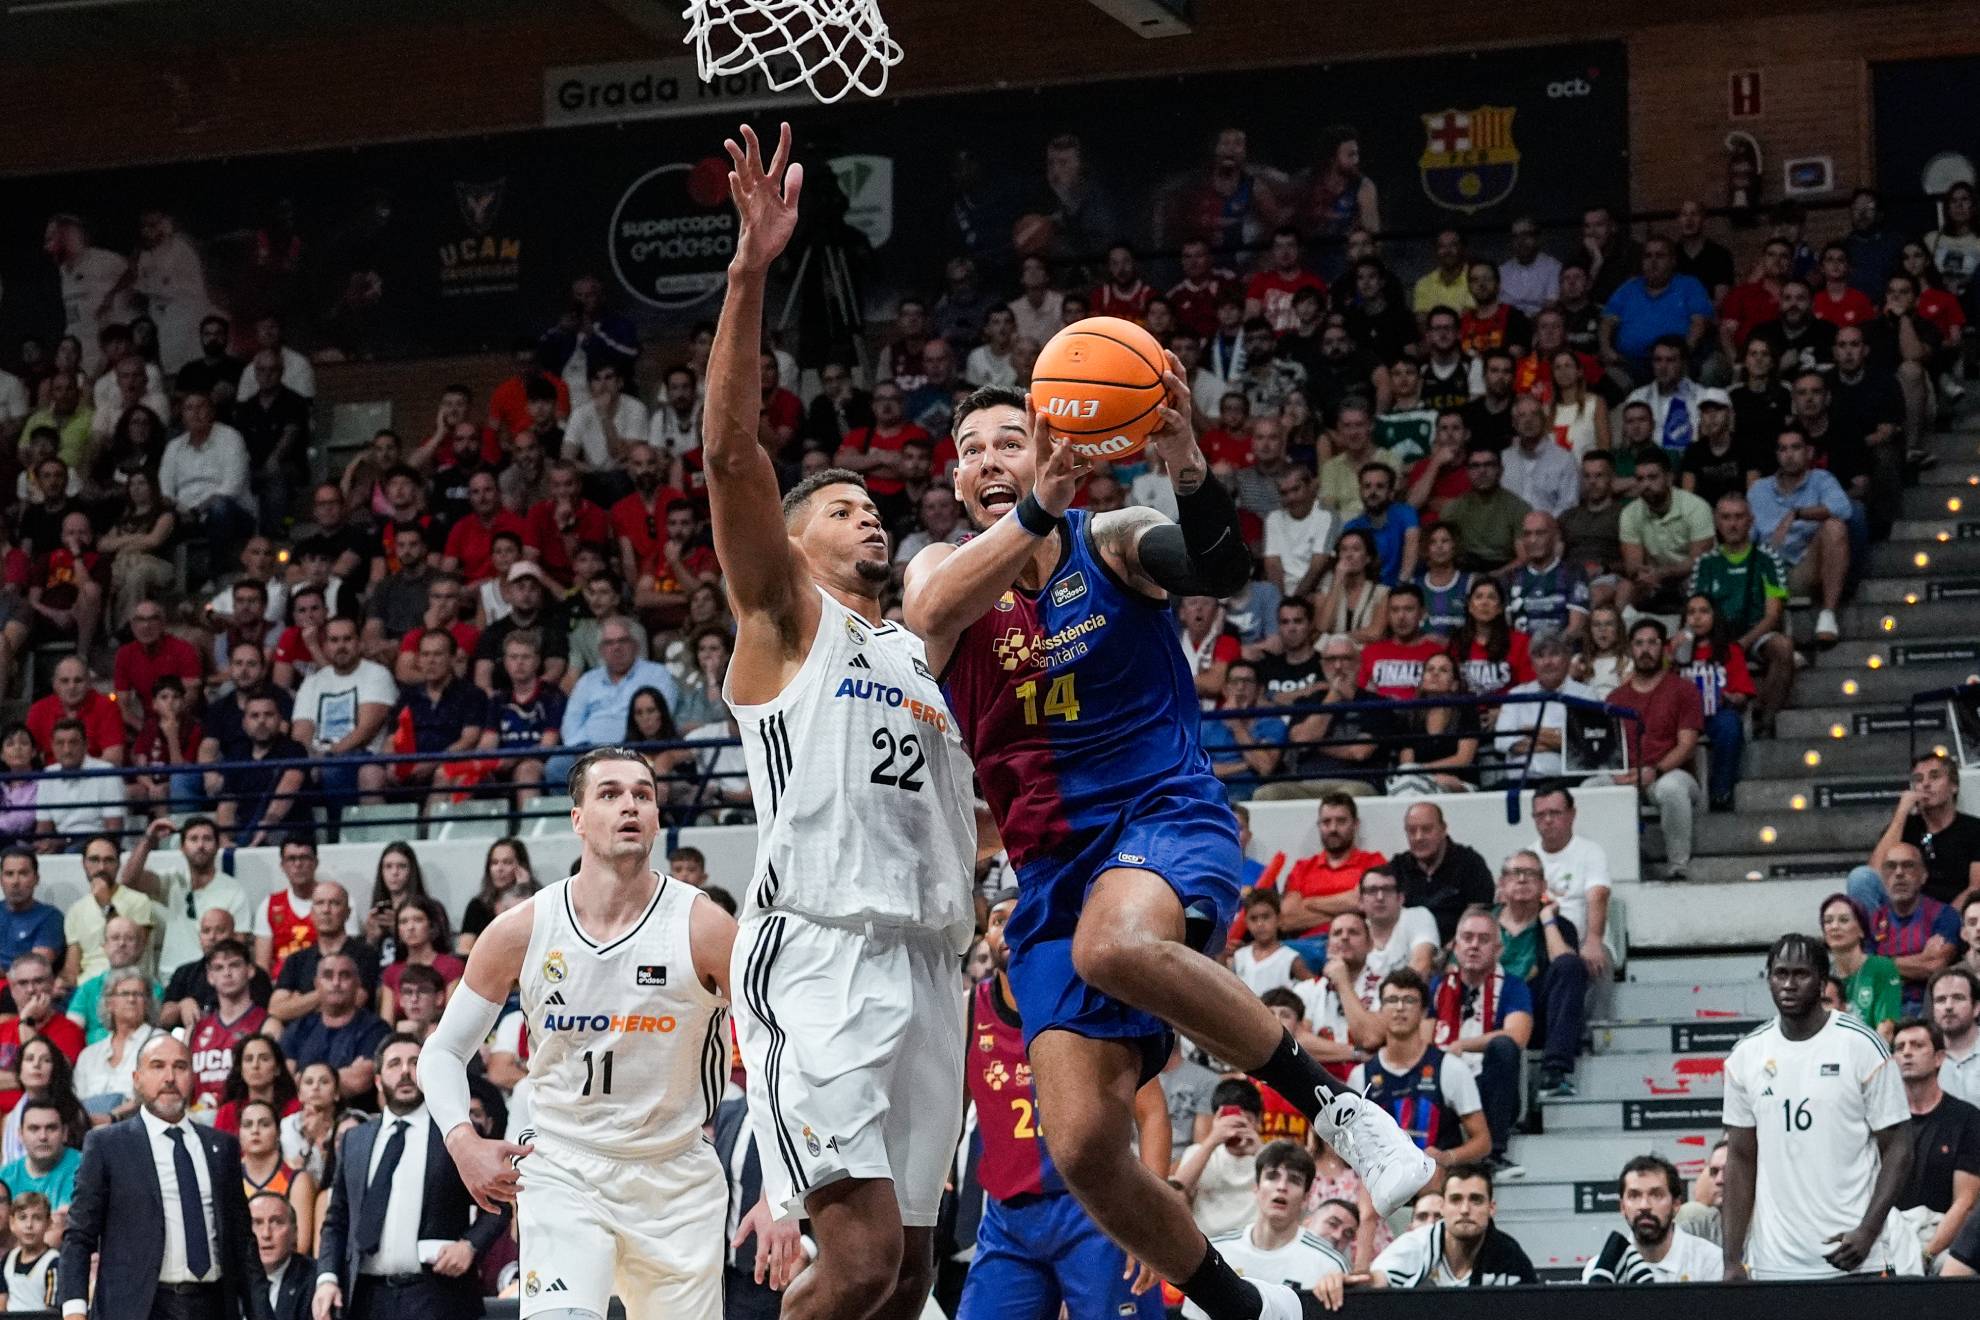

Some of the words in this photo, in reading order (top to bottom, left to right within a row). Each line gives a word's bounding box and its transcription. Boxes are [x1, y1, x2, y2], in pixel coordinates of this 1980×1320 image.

[558, 75, 679, 110] Grada
[1546, 79, 1592, 98] acb
[438, 235, 521, 265] UCAM
[630, 234, 732, 262] endesa
[1047, 397, 1100, 418] EVO
[1054, 587, 1069, 597] liga
[1056, 585, 1084, 603] endesa
[1030, 641, 1089, 669] Sanitària
[1015, 672, 1081, 726] 14
[870, 727, 925, 793] 22
[638, 977, 666, 985] endesa
[544, 1013, 677, 1034] AUTOHERO
[191, 1048, 234, 1073] UCA
[582, 1050, 614, 1097] 11
[1011, 1098, 1044, 1139] 2
[1783, 1098, 1813, 1132] 16
